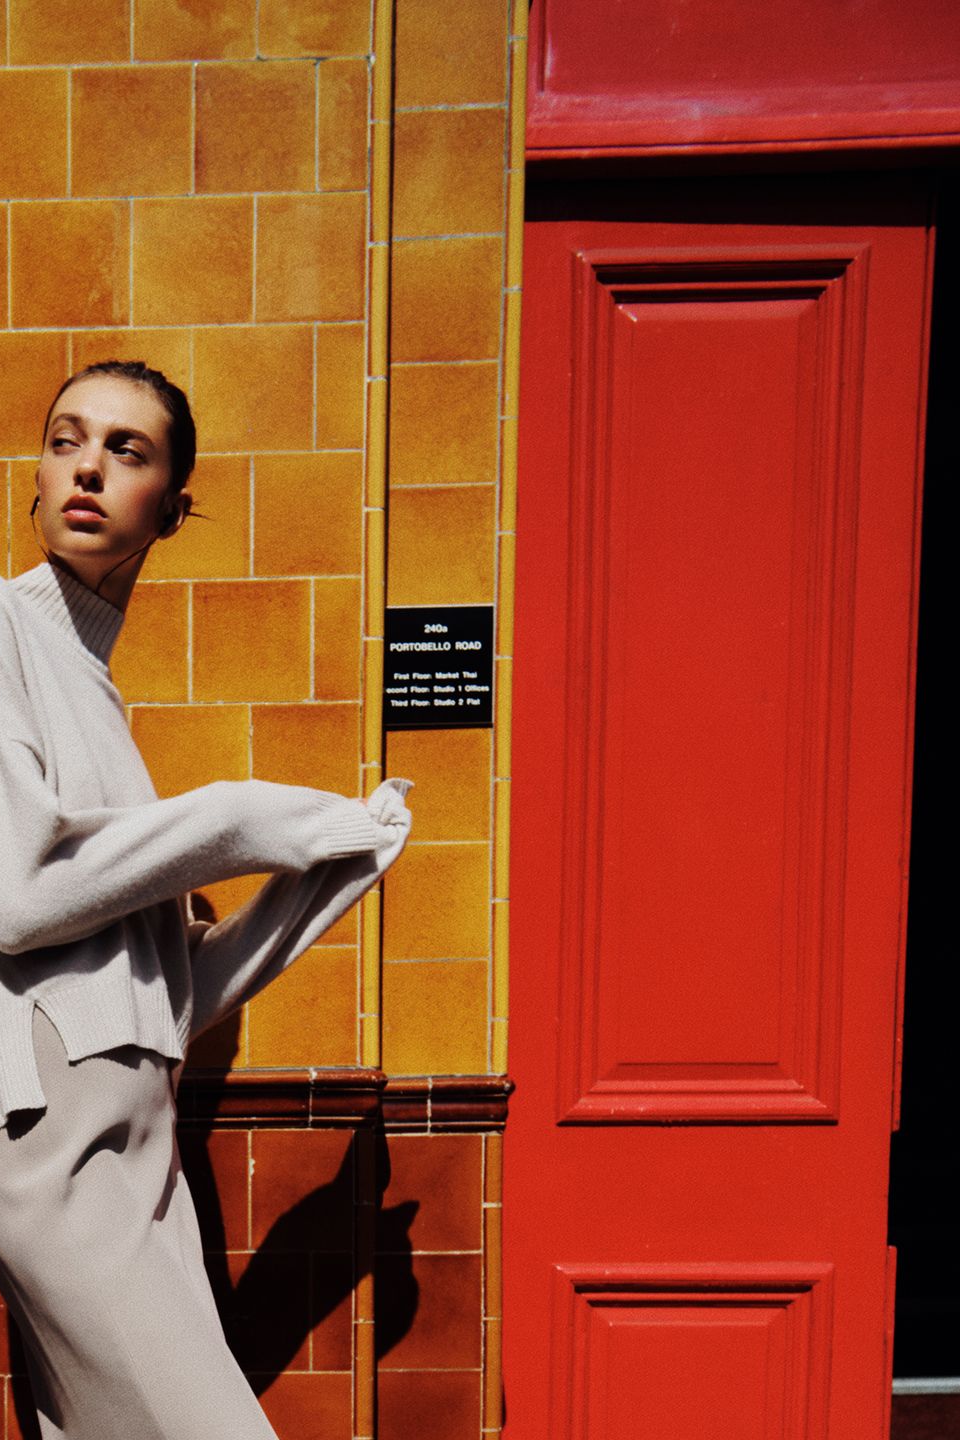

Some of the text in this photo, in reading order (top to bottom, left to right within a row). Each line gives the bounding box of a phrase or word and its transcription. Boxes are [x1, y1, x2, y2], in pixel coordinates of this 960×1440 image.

[390, 641, 482, 652] PORTOBELLO ROAD
[433, 685, 455, 693] Studio
[458, 698, 464, 706] 2
